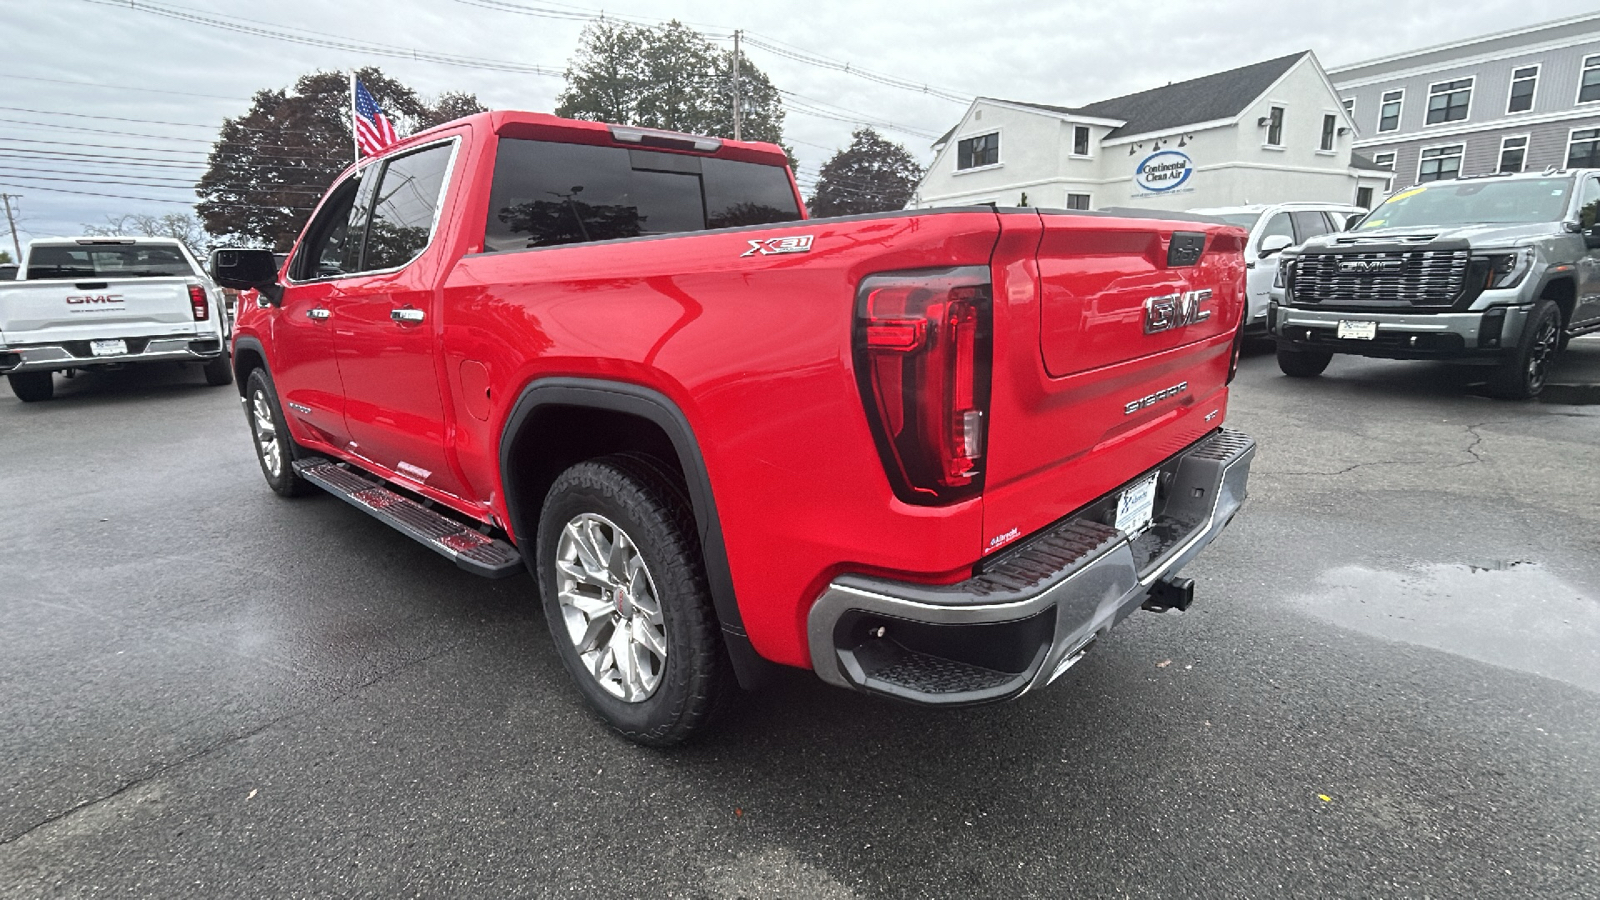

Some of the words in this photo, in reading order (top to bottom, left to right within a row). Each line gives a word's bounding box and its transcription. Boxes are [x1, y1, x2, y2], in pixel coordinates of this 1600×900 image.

[1142, 160, 1186, 174] Continental
[1146, 171, 1168, 182] Clean
[1168, 169, 1182, 179] Air
[740, 235, 814, 257] X31
[1338, 261, 1402, 272] GMC
[66, 295, 125, 305] GMC
[1144, 289, 1212, 334] GMC
[1124, 381, 1188, 415] SIERRA
